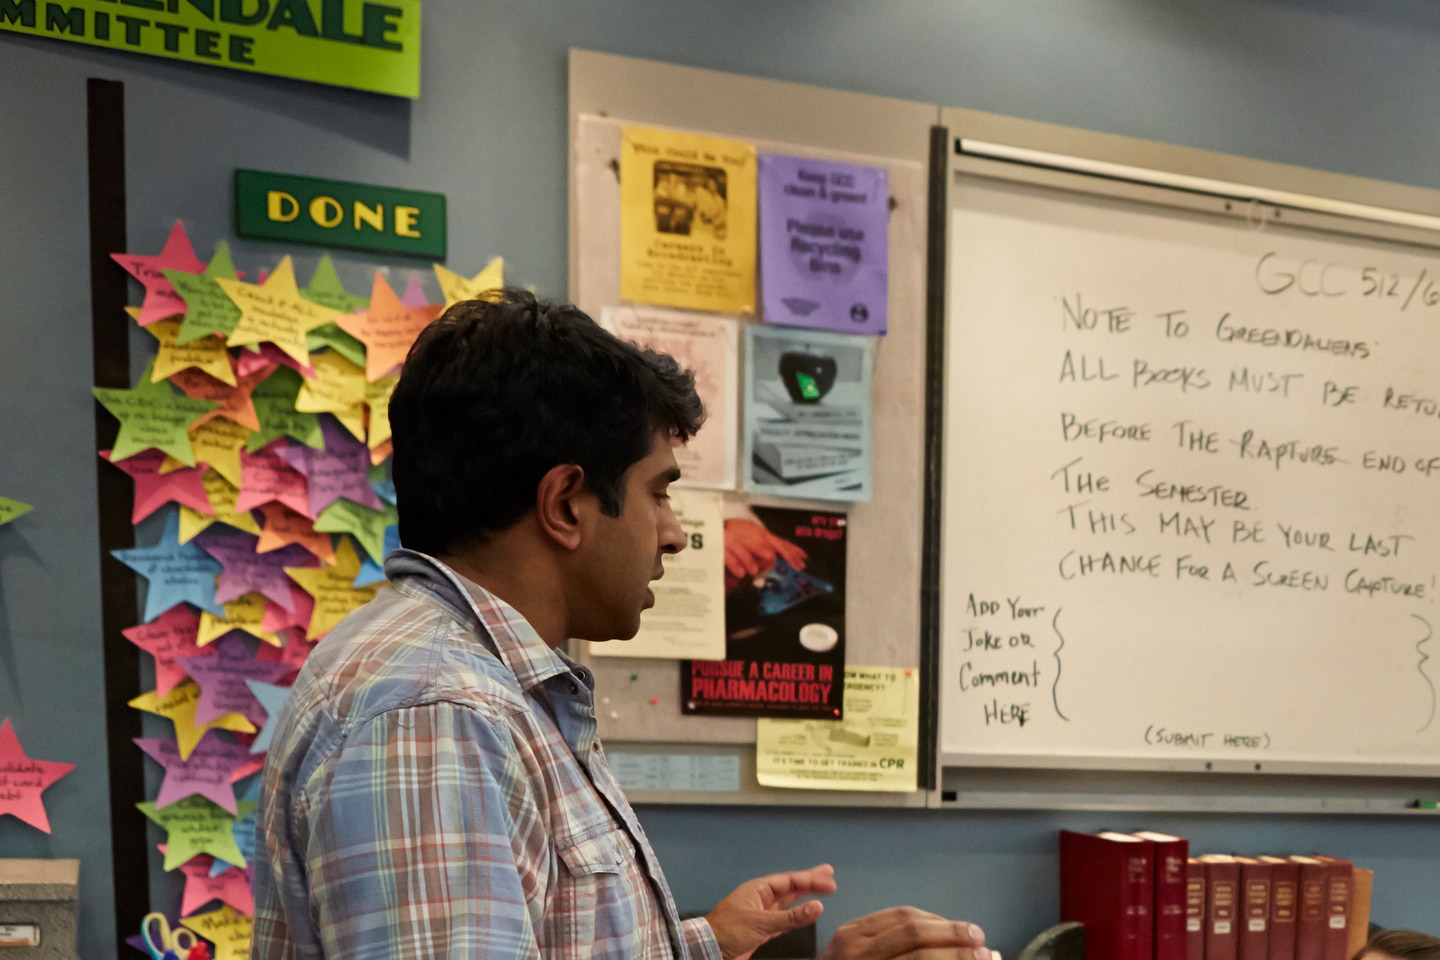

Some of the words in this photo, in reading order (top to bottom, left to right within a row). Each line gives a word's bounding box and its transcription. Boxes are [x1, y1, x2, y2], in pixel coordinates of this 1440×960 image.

[267, 190, 422, 238] DONE
[1255, 251, 1346, 297] GCC
[1062, 293, 1137, 333] NOTE
[1157, 310, 1189, 339] TO
[1059, 349, 1120, 384] ALL
[1228, 367, 1305, 397] MUST
[1323, 380, 1361, 407] BE
[1061, 412, 1152, 443] BEFORE
[1171, 420, 1220, 453] THE
[1362, 451, 1406, 475] END
[1051, 456, 1111, 494] THE
[1057, 500, 1137, 536] THIS
[1159, 511, 1216, 544] MAY
[1233, 519, 1265, 544] BE
[1277, 522, 1336, 551] YOUR
[1349, 533, 1415, 557] LAST
[1058, 549, 1161, 581] CHANCE
[1176, 555, 1209, 581] FOR
[1221, 561, 1237, 582] A
[1252, 559, 1329, 592] SCREEN
[692, 660, 744, 678] PURSUE
[749, 661, 759, 679] A
[763, 661, 815, 681] CAREER
[819, 665, 833, 682] IN
[692, 677, 832, 704] PHARMACOLOGY
[984, 703, 1031, 727] HERE
[879, 758, 905, 770] CPR
